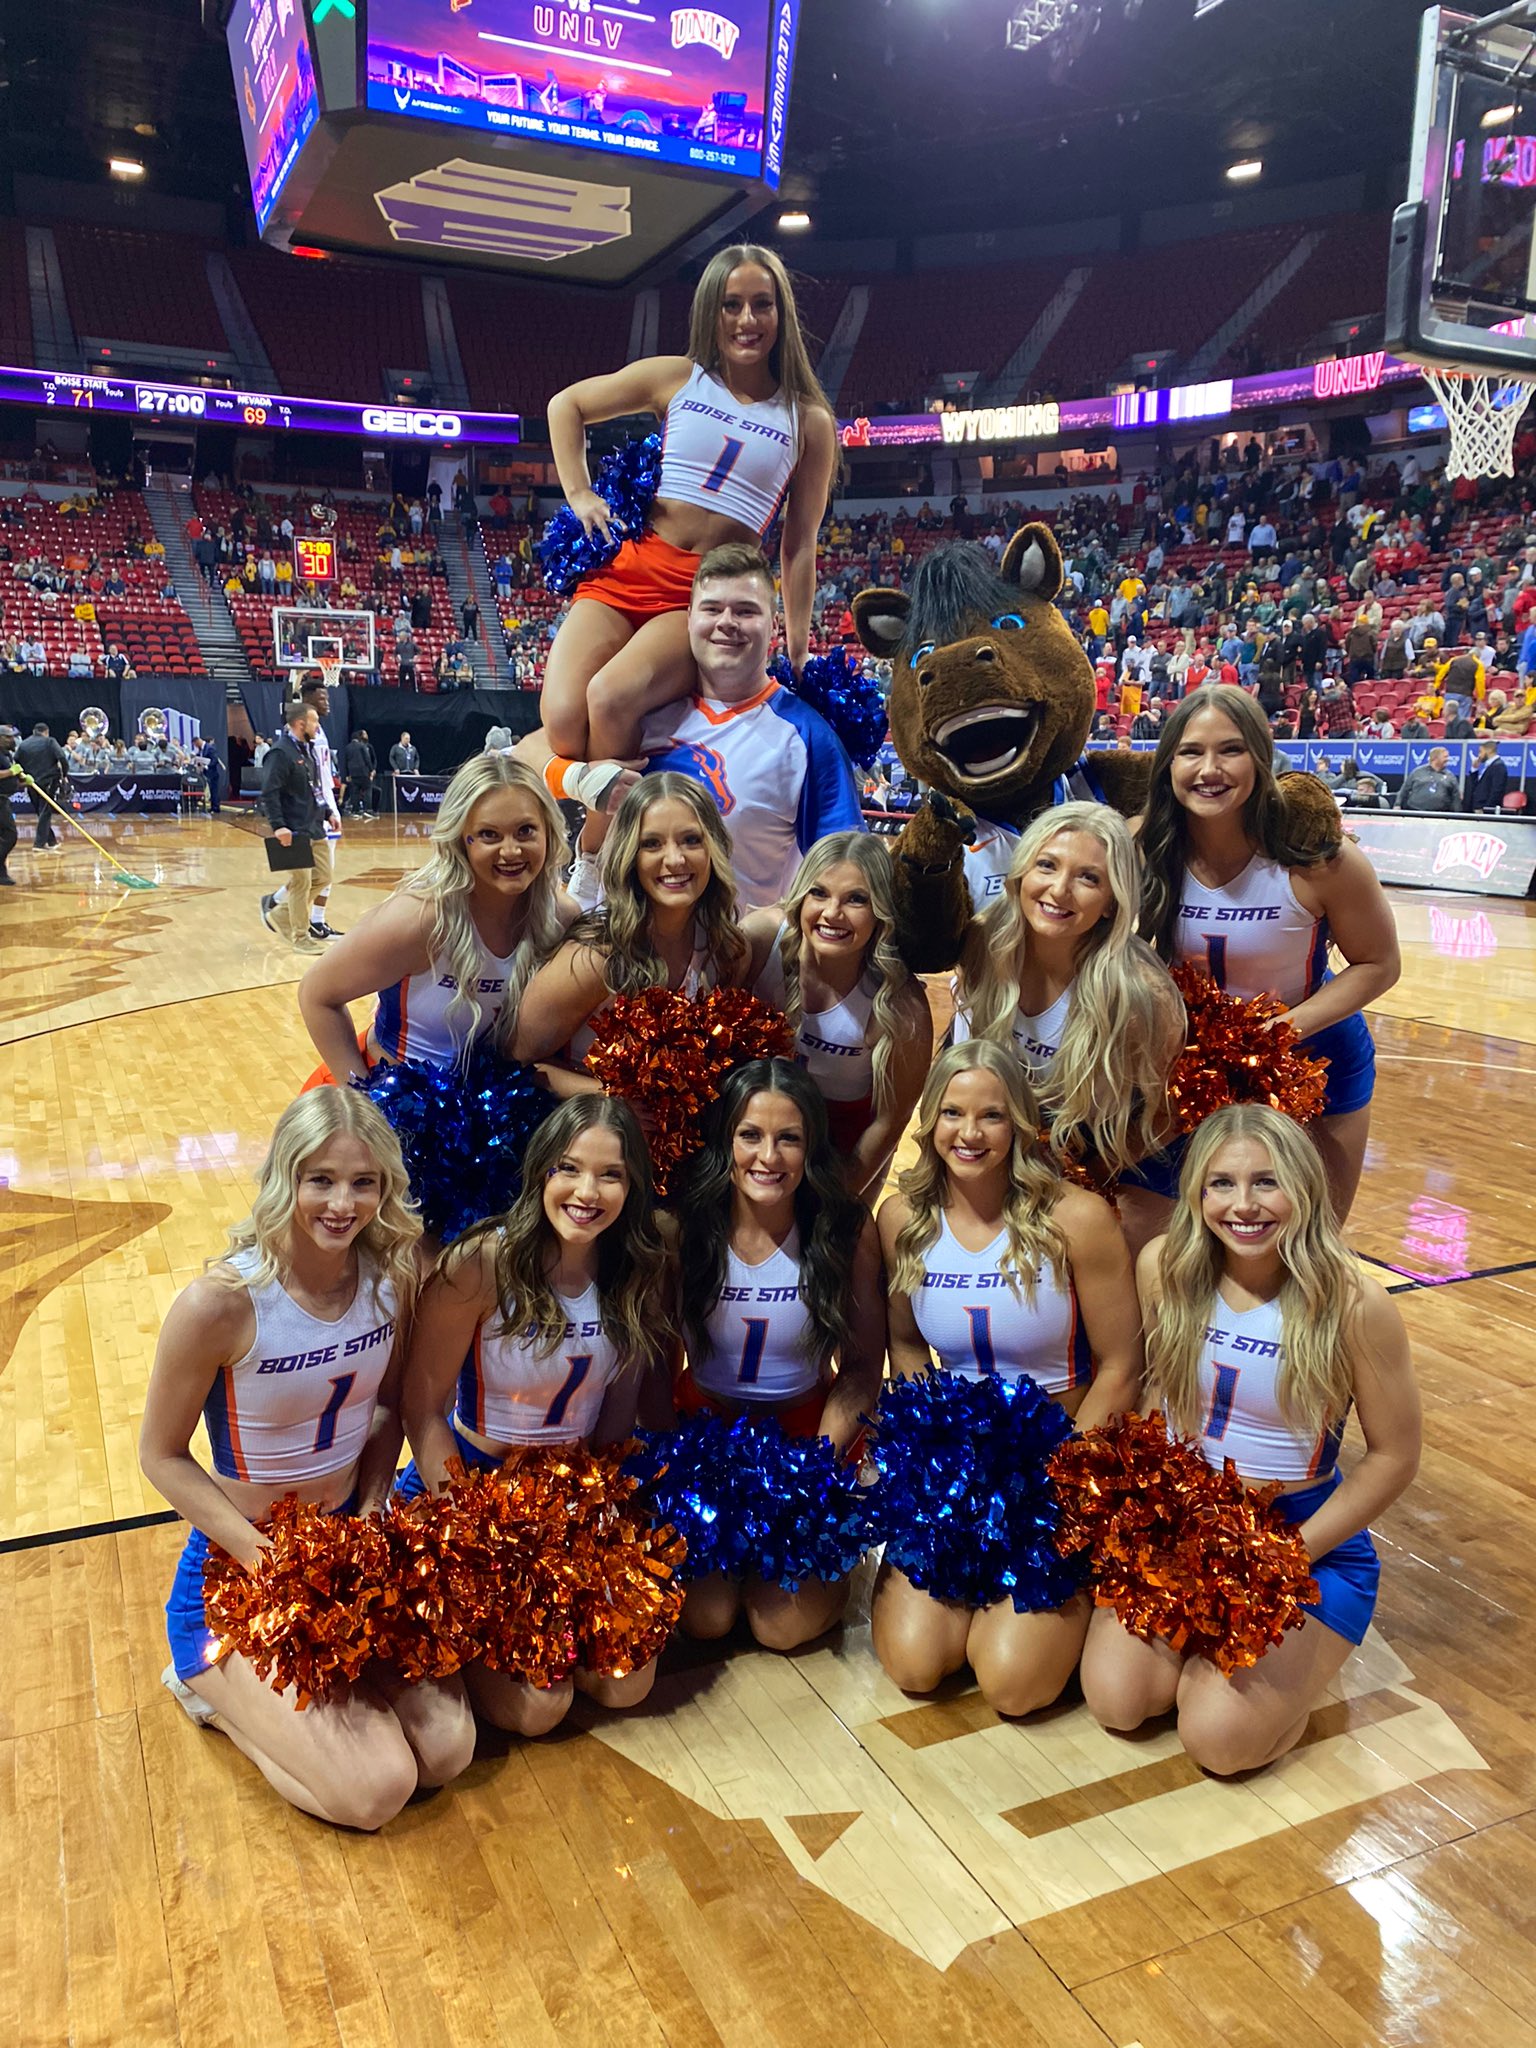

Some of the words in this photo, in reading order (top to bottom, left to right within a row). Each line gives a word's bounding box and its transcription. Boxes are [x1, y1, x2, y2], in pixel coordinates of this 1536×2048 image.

[533, 5, 623, 50] UNLV
[671, 8, 740, 60] UNLV
[487, 110, 511, 126] YOUR
[511, 114, 547, 132] FUTURE.
[548, 121, 571, 136] YOUR
[571, 126, 602, 142] TERMS.
[602, 131, 625, 145] YOUR
[54, 375, 81, 387] BOISE
[83, 379, 109, 390] STATE
[1314, 350, 1386, 398] UNLV
[46, 392, 55, 404] 2
[72, 389, 93, 408] 71
[105, 389, 124, 398] Fouls
[138, 390, 205, 414] 27:00
[237, 395, 272, 407] NEVADA
[243, 406, 267, 424] 69
[283, 416, 291, 428] 1
[362, 408, 462, 437] GEICO
[680, 399, 738, 425] BOISE
[739, 419, 792, 447] STATE
[940, 402, 1060, 442] WYOMING
[699, 434, 745, 496] 1
[304, 554, 328, 575] 30
[1432, 832, 1507, 879] UNLV
[1215, 905, 1281, 921] STATE
[1201, 932, 1228, 991] 1
[800, 1031, 863, 1057] STATE
[737, 1316, 770, 1384] 1
[962, 1305, 996, 1376] 1
[256, 1343, 339, 1375] BOISE
[311, 1371, 357, 1454] 1
[1203, 1360, 1241, 1442] 1
